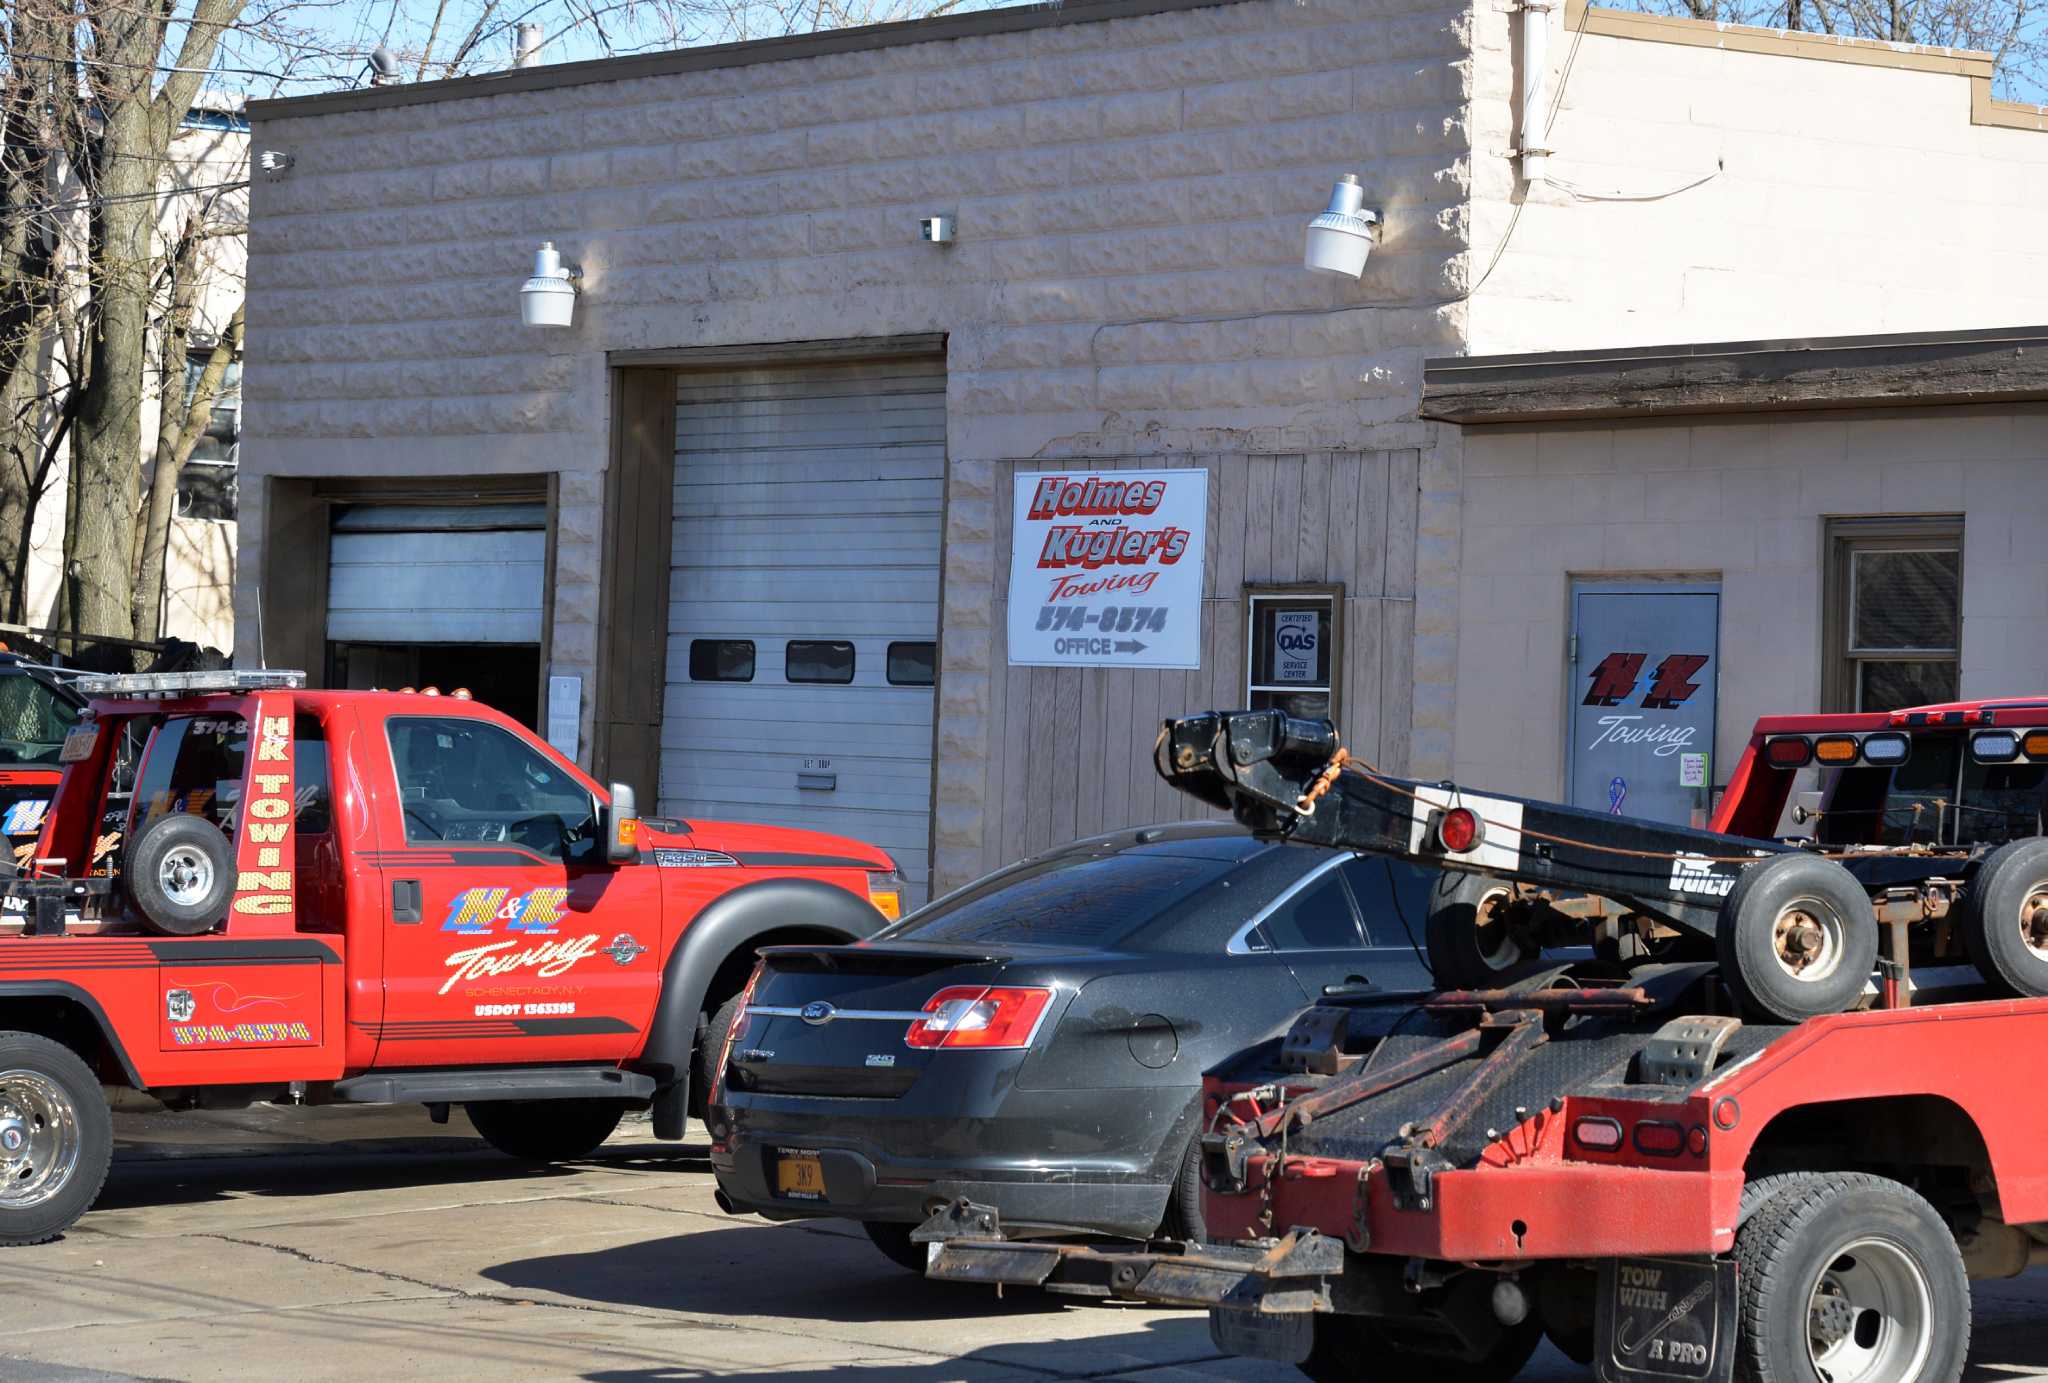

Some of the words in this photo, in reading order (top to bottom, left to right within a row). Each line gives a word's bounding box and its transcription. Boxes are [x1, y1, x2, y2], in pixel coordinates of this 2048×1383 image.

[1027, 477, 1167, 520] Holmes
[1089, 518, 1122, 526] AND
[1037, 526, 1190, 570] Kugler's
[1048, 571, 1160, 602] Towing
[1054, 638, 1111, 655] OFFICE
[1280, 633, 1316, 650] DAS
[1589, 715, 1697, 757] Towing
[233, 774, 293, 915] TOWING
[438, 934, 601, 995] Towing
[475, 1003, 521, 1017] USDOT
[1621, 1266, 1663, 1287] TOW
[1619, 1286, 1668, 1311] WITH
[1648, 1339, 1664, 1360] A
[1668, 1341, 1706, 1365] PRO
